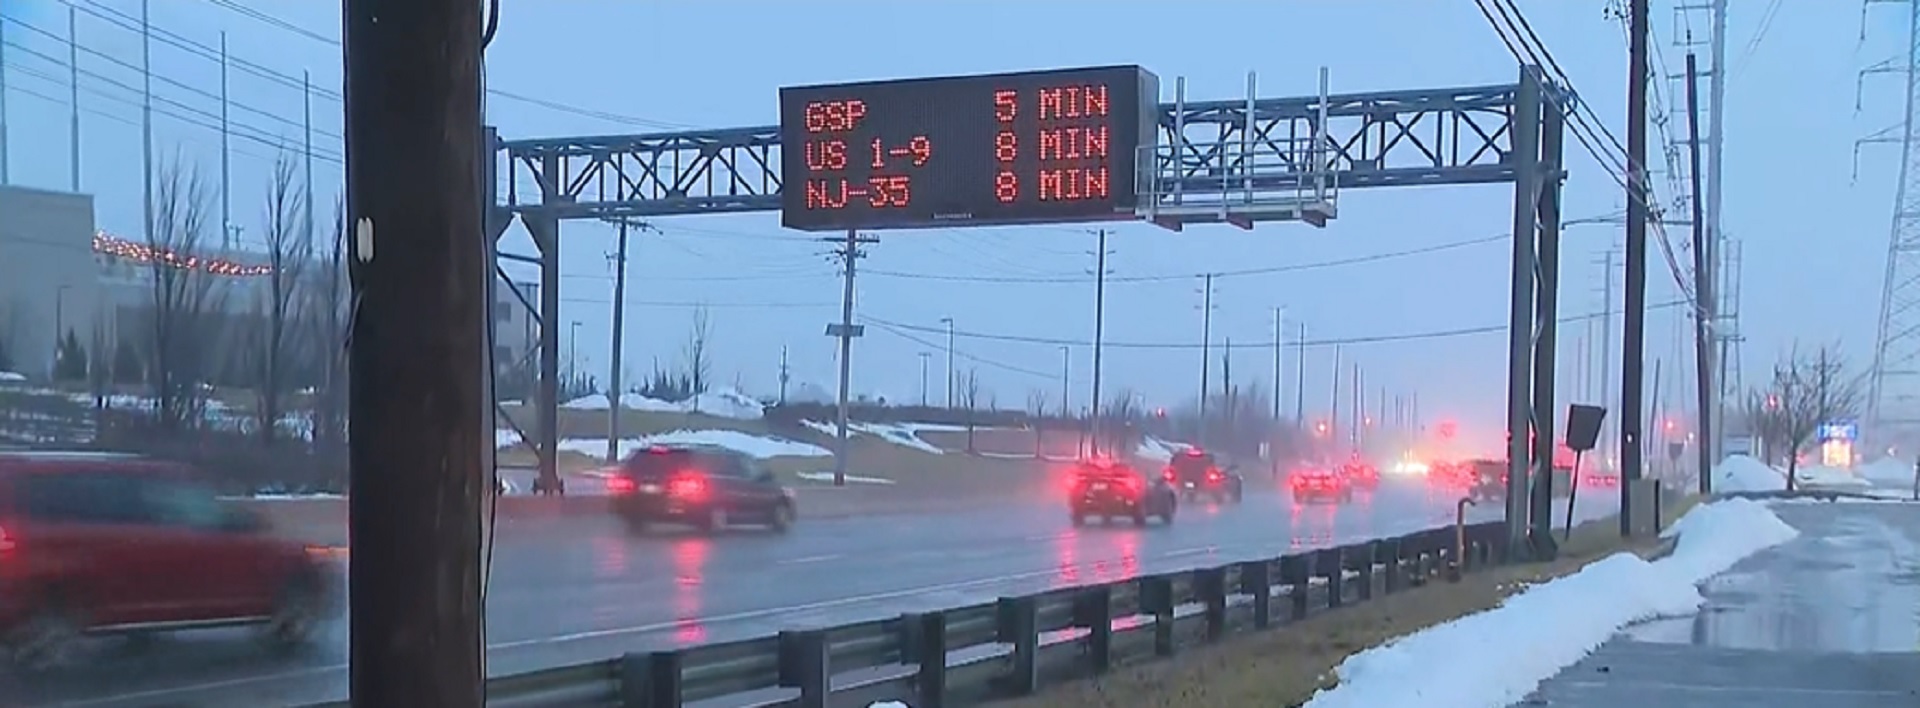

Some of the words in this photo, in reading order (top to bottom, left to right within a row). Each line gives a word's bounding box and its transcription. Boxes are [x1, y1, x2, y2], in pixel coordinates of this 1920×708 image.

[805, 100, 866, 132] GSP
[995, 90, 1017, 121] 5
[1039, 85, 1108, 119] MIN
[806, 140, 847, 170] US
[871, 136, 931, 168] 1-9
[995, 131, 1017, 161] 8
[1039, 126, 1108, 160] MIN
[806, 176, 910, 208] NJ-35
[995, 171, 1017, 202] 8
[1039, 167, 1108, 200] MIN
